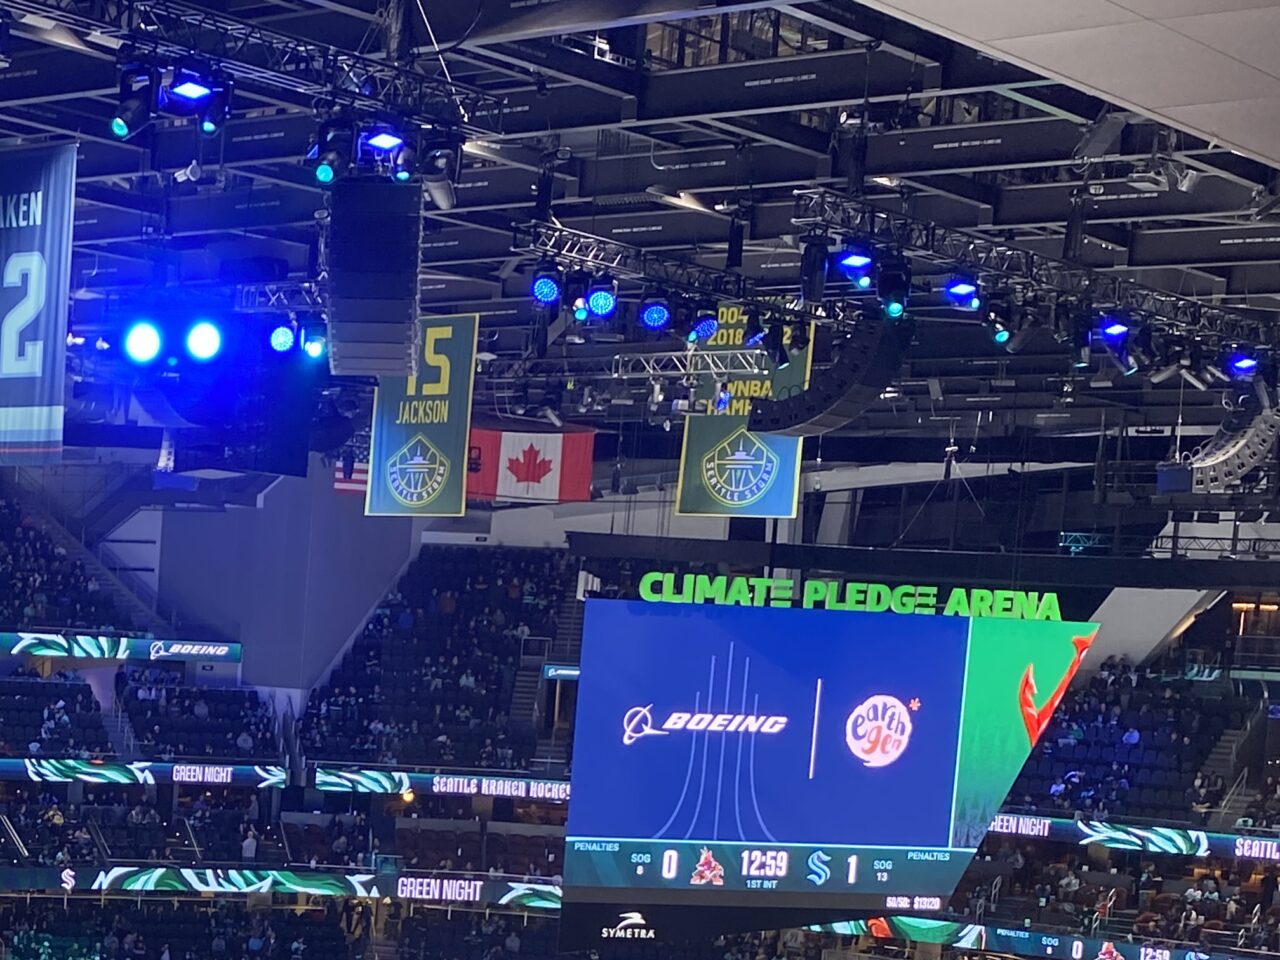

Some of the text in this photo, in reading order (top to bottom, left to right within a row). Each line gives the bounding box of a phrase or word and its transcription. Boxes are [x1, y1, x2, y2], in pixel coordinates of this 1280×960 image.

[396, 400, 448, 425] JACKSON
[707, 461, 773, 501] SEATTLE STORM
[638, 571, 1062, 621] CLIMATE PLEDGE ARENA
[169, 643, 228, 656] BOEING
[663, 711, 787, 734] BOEING
[851, 699, 907, 738] earth
[867, 731, 902, 756] gen
[172, 765, 233, 784] GREEN NIGHT
[432, 775, 477, 794] SEATTLE
[481, 777, 526, 796] KRAKEN
[989, 815, 1051, 837] REEN NIGHT
[574, 842, 619, 852] PENALTIES
[907, 851, 950, 862] PENALTIES
[1235, 837, 1280, 859] SEATTL
[630, 853, 651, 864] SOG
[662, 849, 678, 879] 0
[740, 850, 788, 878] 12:59
[874, 860, 892, 870] SOG
[847, 855, 858, 884] 1
[877, 872, 888, 881] 13
[397, 876, 483, 901] GREEN NIGHT
[764, 880, 777, 889] INT
[601, 928, 655, 940] SYMETRA
[1042, 937, 1059, 946] SOG
[1071, 940, 1083, 960] 0
